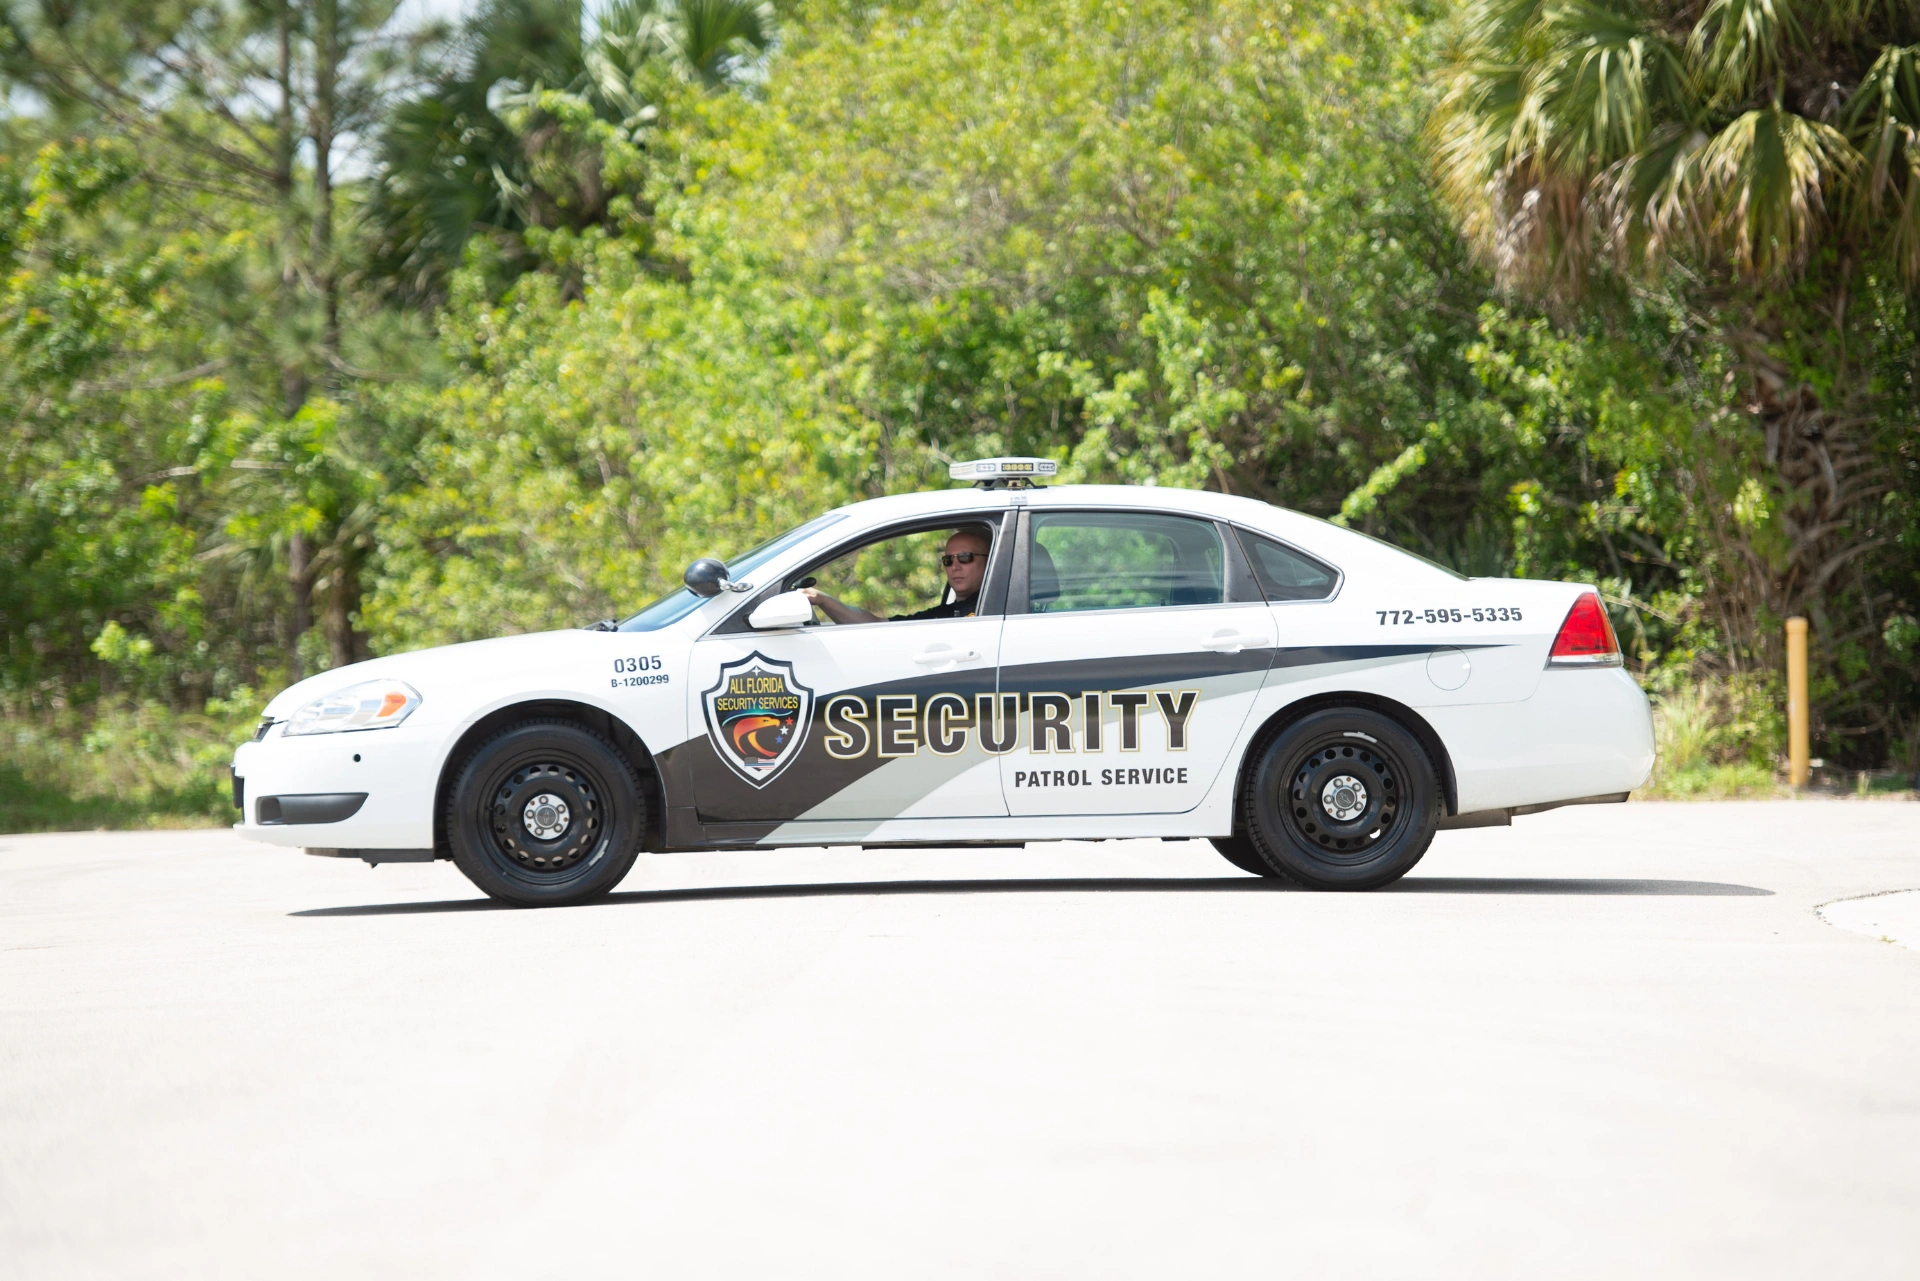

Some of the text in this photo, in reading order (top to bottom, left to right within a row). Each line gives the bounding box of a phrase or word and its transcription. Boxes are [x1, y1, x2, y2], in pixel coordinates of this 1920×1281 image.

[1376, 607, 1523, 625] 772-595-5335
[614, 655, 662, 673] 0305
[611, 674, 669, 688] B-1200299
[730, 677, 784, 694] ALL FLORIDA
[717, 696, 799, 711] SECURITY SERVICES
[824, 690, 1200, 759] SECURITY
[1015, 767, 1188, 788] PATROL SERVICE
